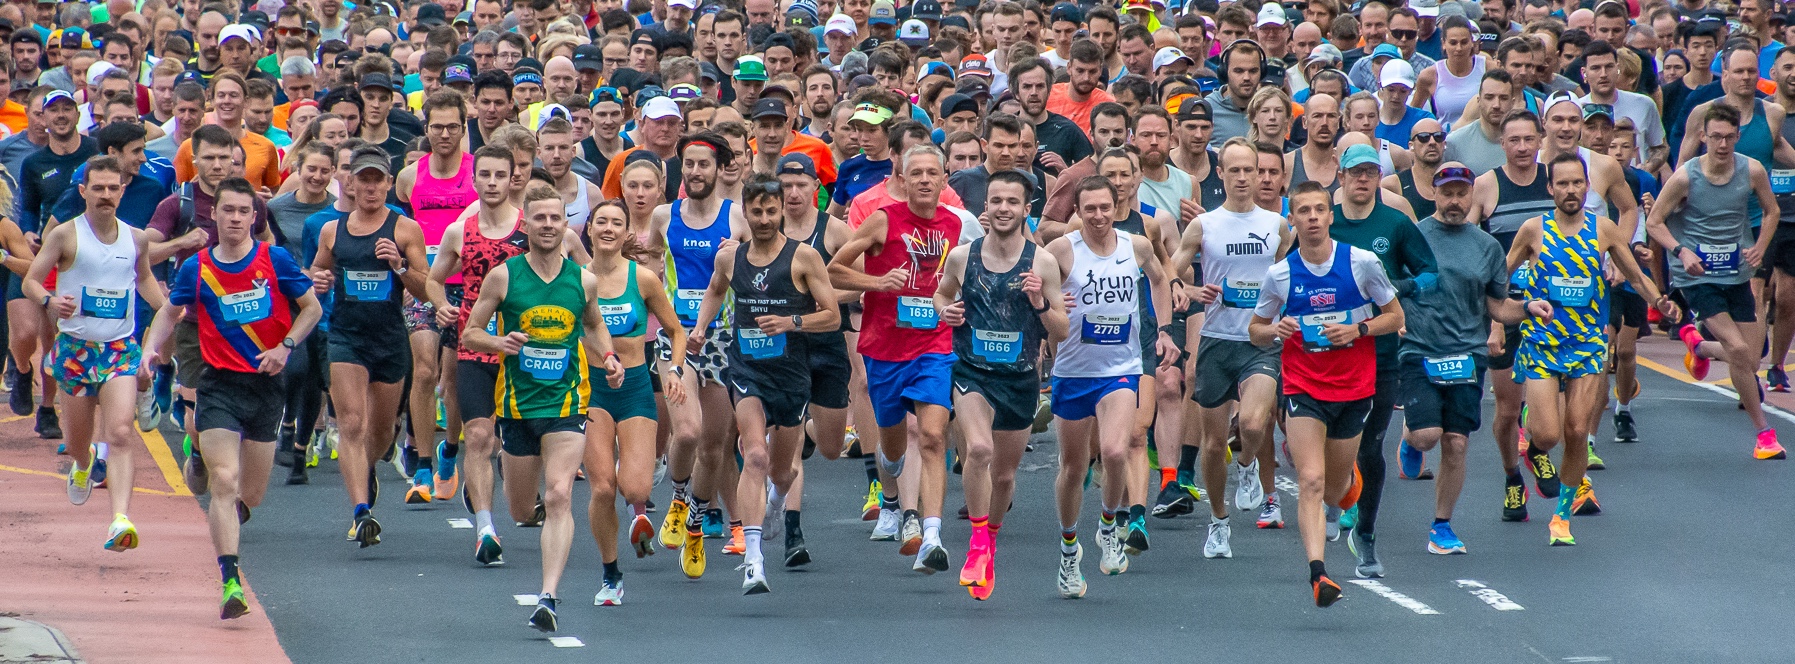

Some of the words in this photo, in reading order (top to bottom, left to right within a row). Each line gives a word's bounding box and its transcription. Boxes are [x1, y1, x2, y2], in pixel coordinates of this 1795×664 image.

[1771, 177, 1791, 186] 582
[683, 238, 712, 248] knox
[1226, 242, 1263, 256] PUMA
[1706, 253, 1731, 262] 2520
[357, 282, 379, 291] 1517
[1099, 275, 1134, 291] run
[1082, 289, 1134, 305] crew
[1237, 290, 1257, 299] 703
[1560, 287, 1584, 298] 1075
[96, 298, 117, 309] 803
[233, 300, 260, 315] 1759
[525, 307, 574, 320] EMERALD
[909, 307, 935, 318] 1639
[603, 314, 628, 326] SSY
[1093, 324, 1121, 335] 2778
[749, 338, 774, 349] 1674
[984, 341, 1011, 353] 1666
[524, 358, 563, 371] CRAIG
[1437, 360, 1463, 372] 1334
